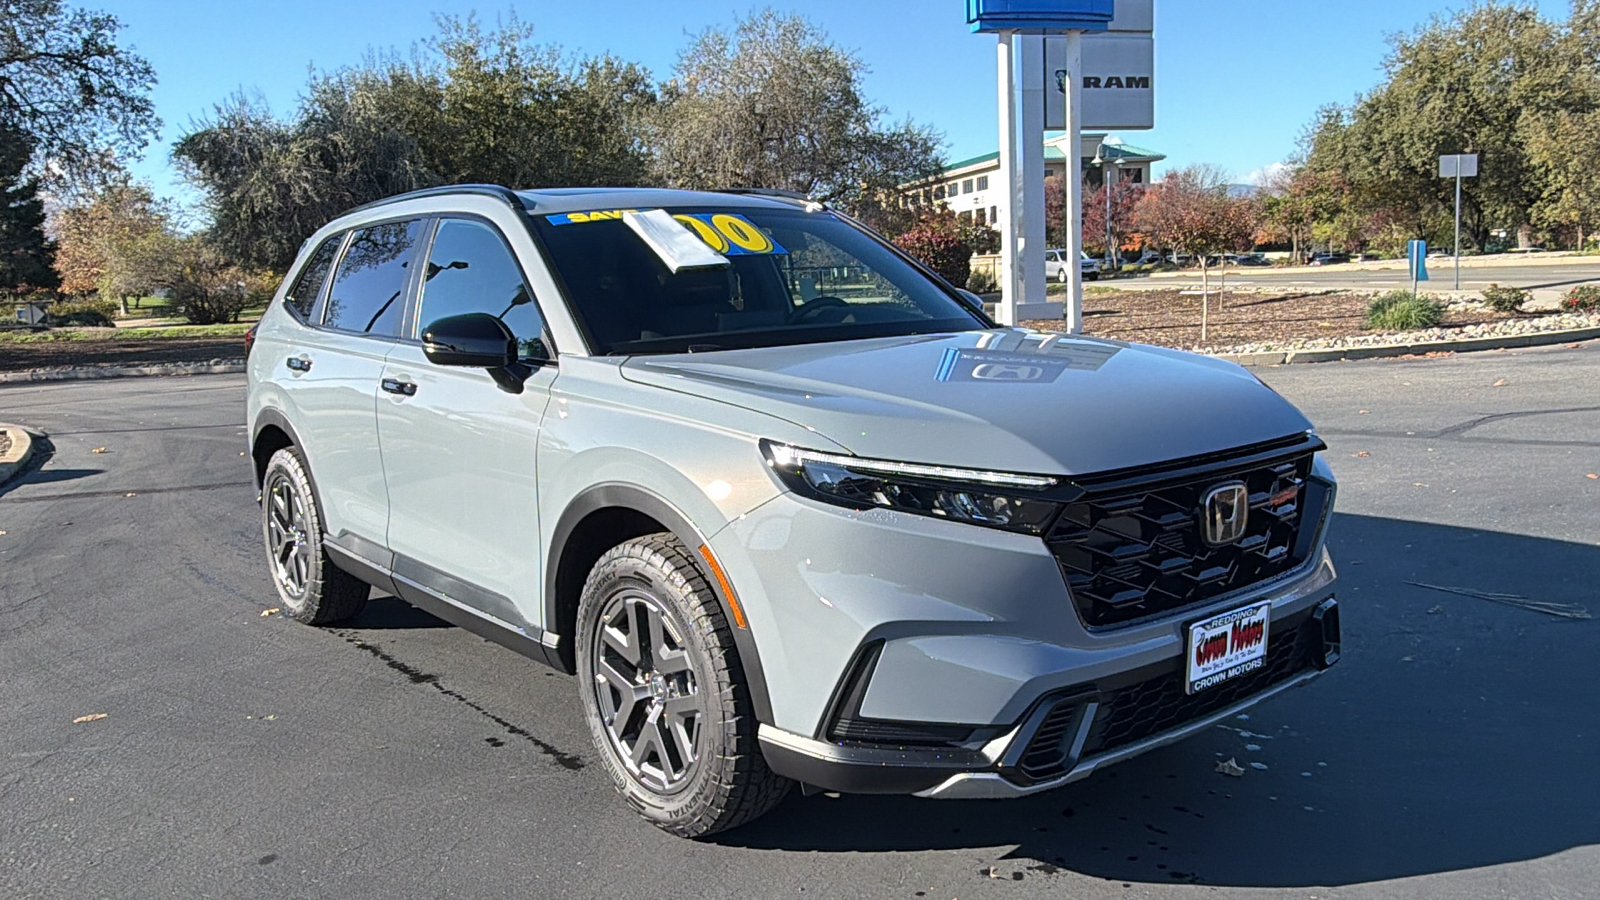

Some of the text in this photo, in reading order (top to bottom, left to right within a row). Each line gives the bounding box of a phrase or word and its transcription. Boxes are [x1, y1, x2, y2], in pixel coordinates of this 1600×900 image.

[1083, 76, 1149, 89] RAM
[567, 209, 638, 223] SAV
[1211, 608, 1253, 629] REDDING
[1194, 672, 1226, 691] CROWN
[1227, 658, 1262, 679] MOTORS
